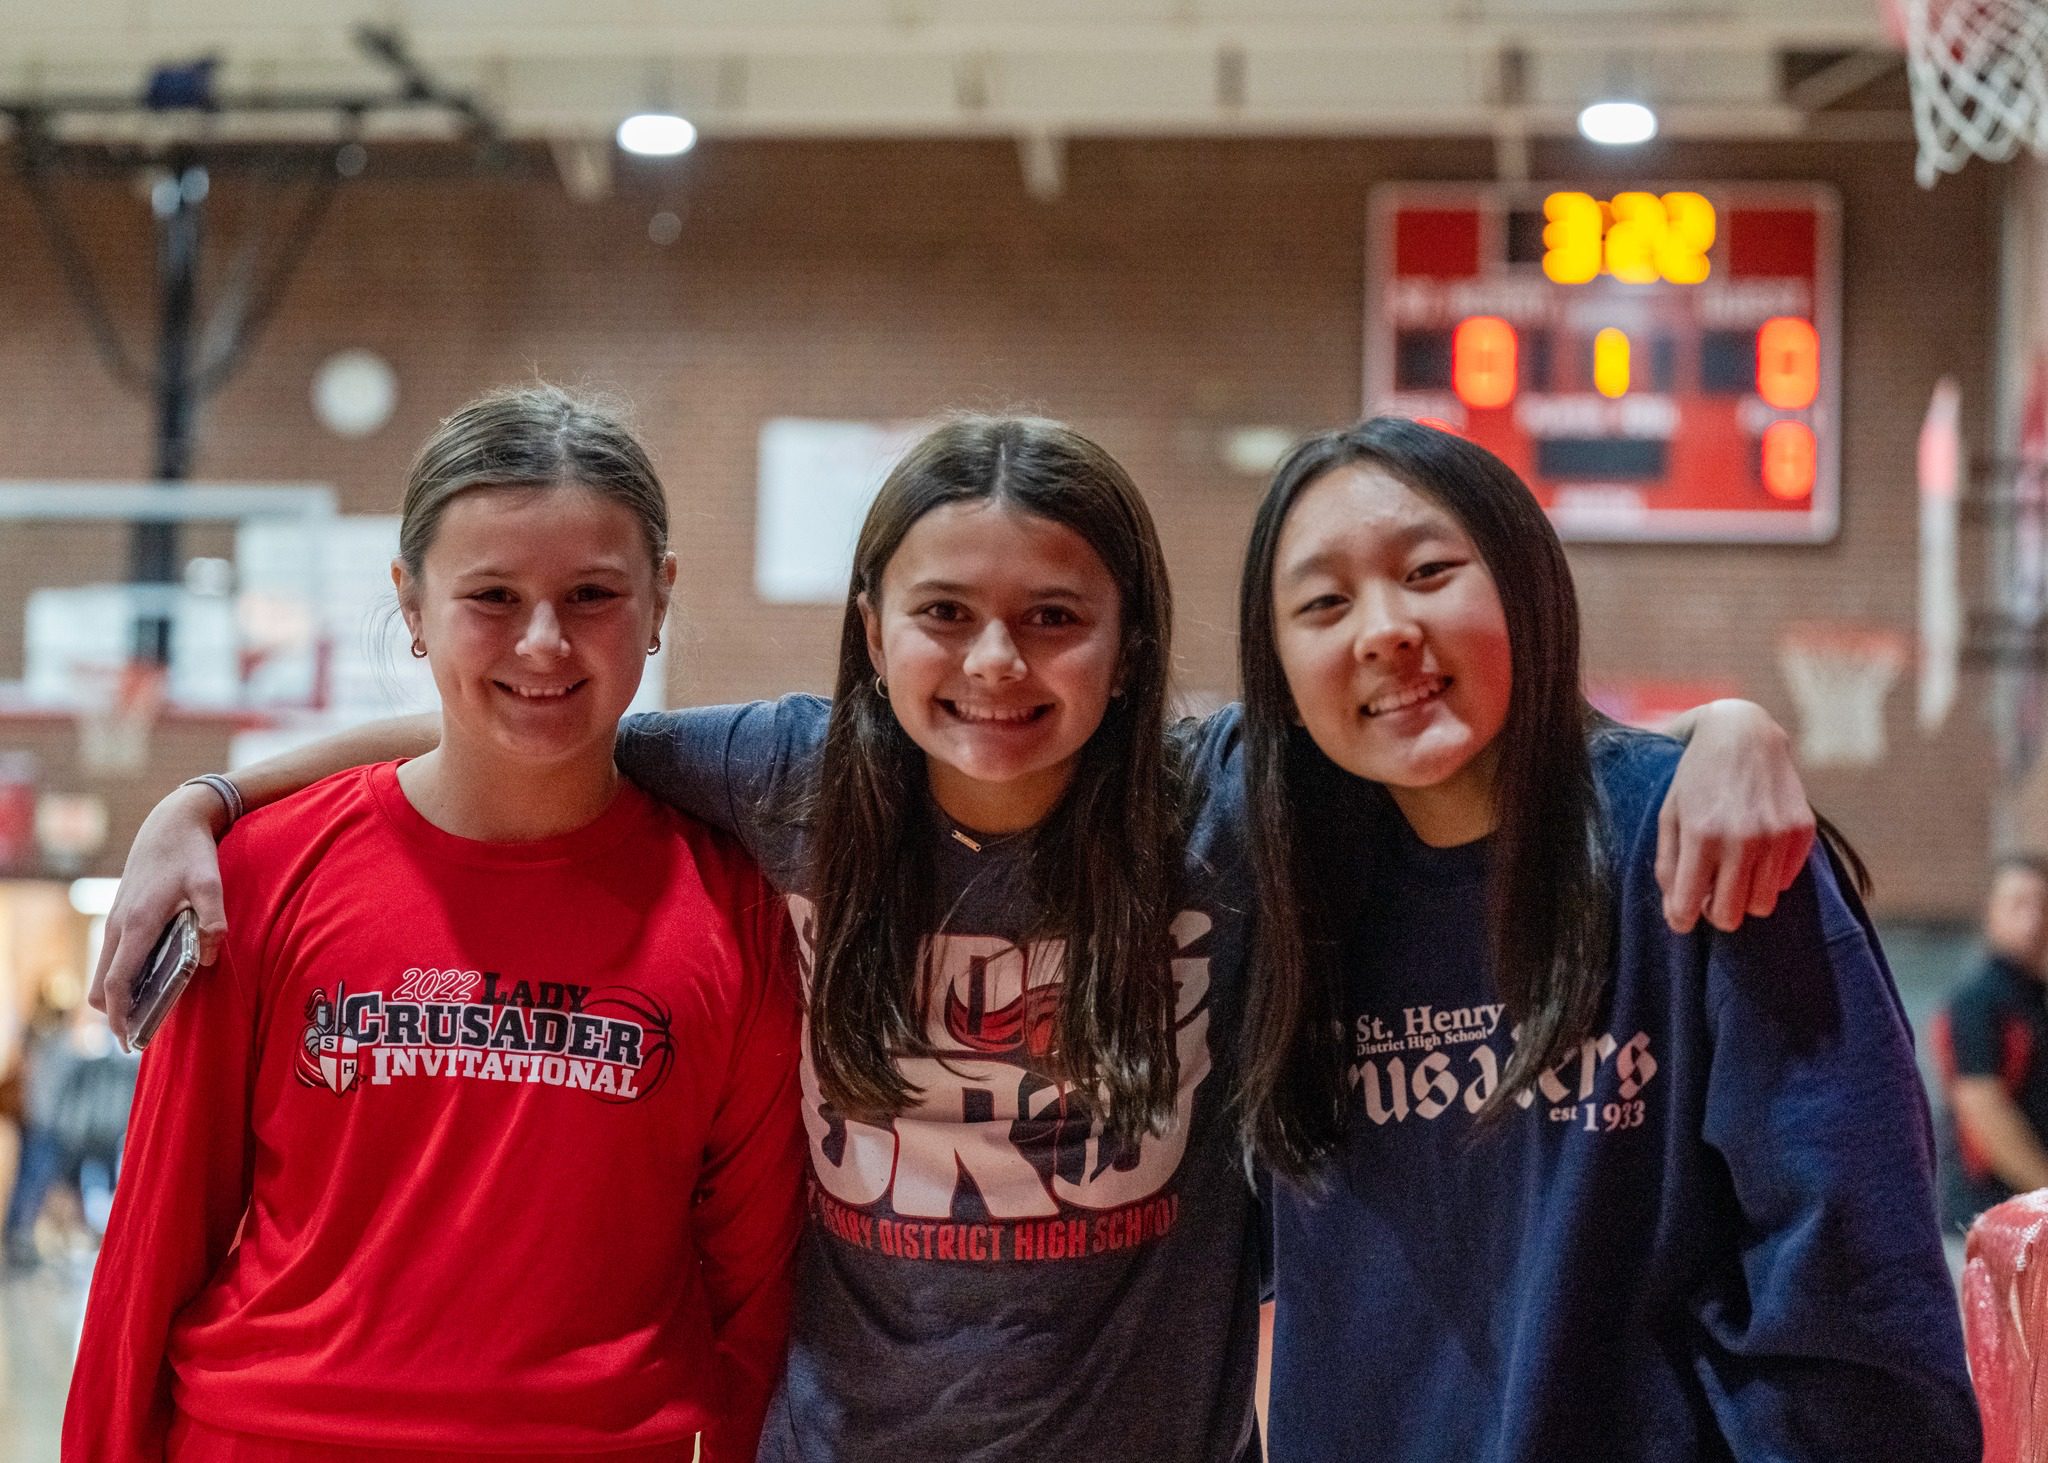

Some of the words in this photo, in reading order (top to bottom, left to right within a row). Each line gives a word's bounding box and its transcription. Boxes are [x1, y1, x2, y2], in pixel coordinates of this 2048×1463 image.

[1594, 327, 1631, 399] 1
[391, 967, 482, 1002] 2022
[480, 971, 592, 1013] LADY
[345, 990, 644, 1069] CRUSADER
[1356, 1014, 1394, 1043] St.
[1403, 1003, 1507, 1036] Henry
[1356, 1040, 1405, 1056] District
[1407, 1033, 1442, 1051] High
[1445, 1022, 1488, 1045] School
[371, 1047, 639, 1099] INVITATIONAL
[1550, 1108, 1578, 1122] est
[1582, 1100, 1646, 1133] 1933
[877, 1218, 1005, 1261] DISTRICT
[1013, 1219, 1088, 1261] HIGH
